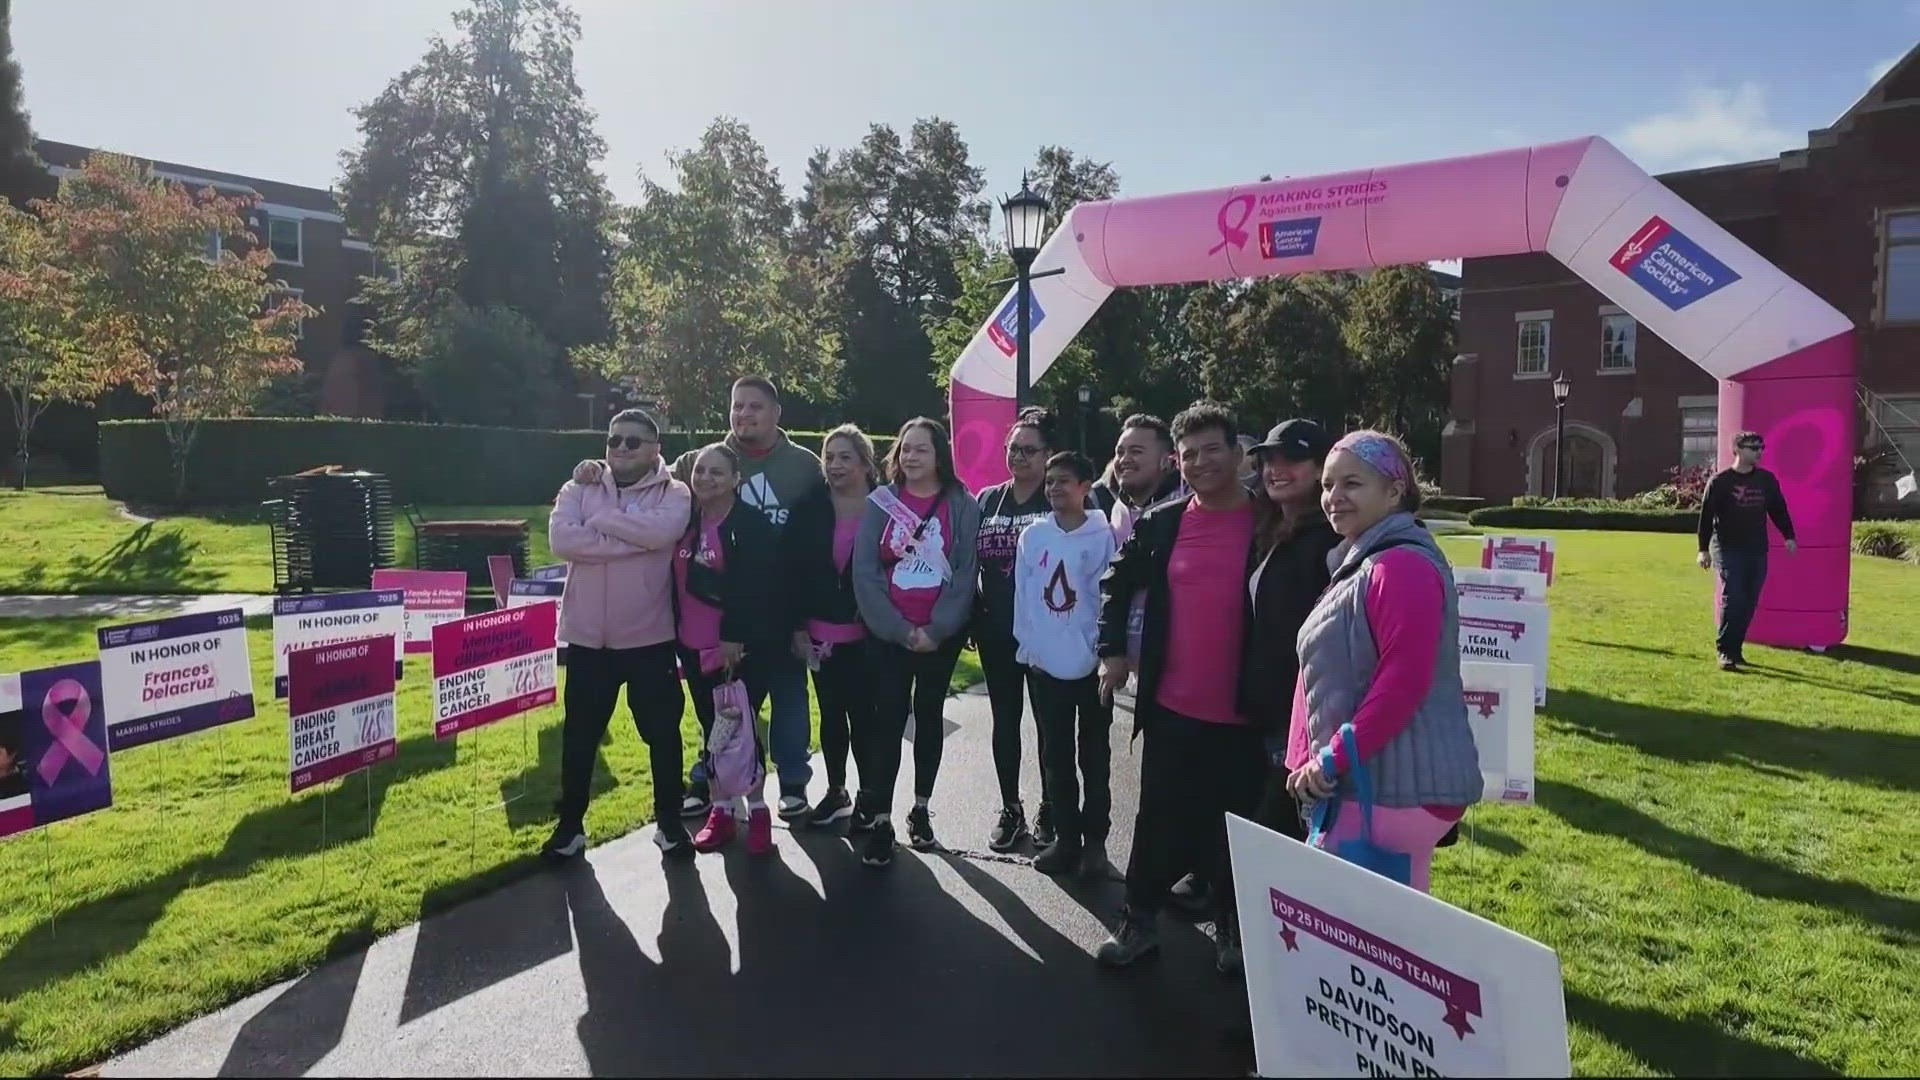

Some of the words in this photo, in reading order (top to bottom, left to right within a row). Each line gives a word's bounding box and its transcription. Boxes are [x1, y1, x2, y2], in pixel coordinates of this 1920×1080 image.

[1259, 188, 1322, 205] MAKING
[1327, 180, 1388, 198] STRIDES
[1259, 204, 1302, 217] Against
[1304, 199, 1342, 212] Breast
[1345, 194, 1385, 207] Cancer
[1650, 250, 1691, 283] Cancer
[1658, 242, 1715, 286] American
[994, 534, 1017, 548] TH
[217, 614, 240, 626] 2025
[298, 618, 312, 630] IN
[315, 614, 360, 628] HONOR
[363, 612, 380, 623] OF
[463, 620, 474, 632] IN
[475, 613, 511, 629] HONOR
[512, 610, 526, 620] OF
[130, 650, 146, 665] IN
[149, 642, 200, 660] HONOR
[203, 637, 222, 651] OF
[1467, 634, 1498, 647] TEAM
[315, 652, 325, 664] IN
[326, 647, 357, 662] HONOR
[358, 645, 369, 656] OF
[504, 657, 533, 672] STARTS
[533, 652, 553, 664] WITH
[144, 663, 210, 686] Frances
[439, 667, 486, 690] ENDING
[142, 676, 215, 702] Delacruz
[439, 681, 486, 705] BREAST
[351, 701, 375, 717] STARTS
[440, 693, 491, 718] CANCER
[115, 724, 149, 738] MAKING
[149, 715, 182, 730] STRIDES
[294, 710, 336, 733] ENDING
[294, 726, 336, 750] BREAST
[295, 741, 340, 767] CANCER
[1272, 897, 1295, 918] TOP
[1297, 910, 1312, 926] 25
[1314, 917, 1403, 970] FUNDRAISING
[1405, 960, 1452, 996] TEAM!
[1350, 964, 1395, 1004] D.A.
[1319, 976, 1435, 1059] DAVIDSON
[1305, 995, 1379, 1053] PRETTY
[1384, 1039, 1407, 1072] IN
[1356, 1051, 1400, 1079] PIN
